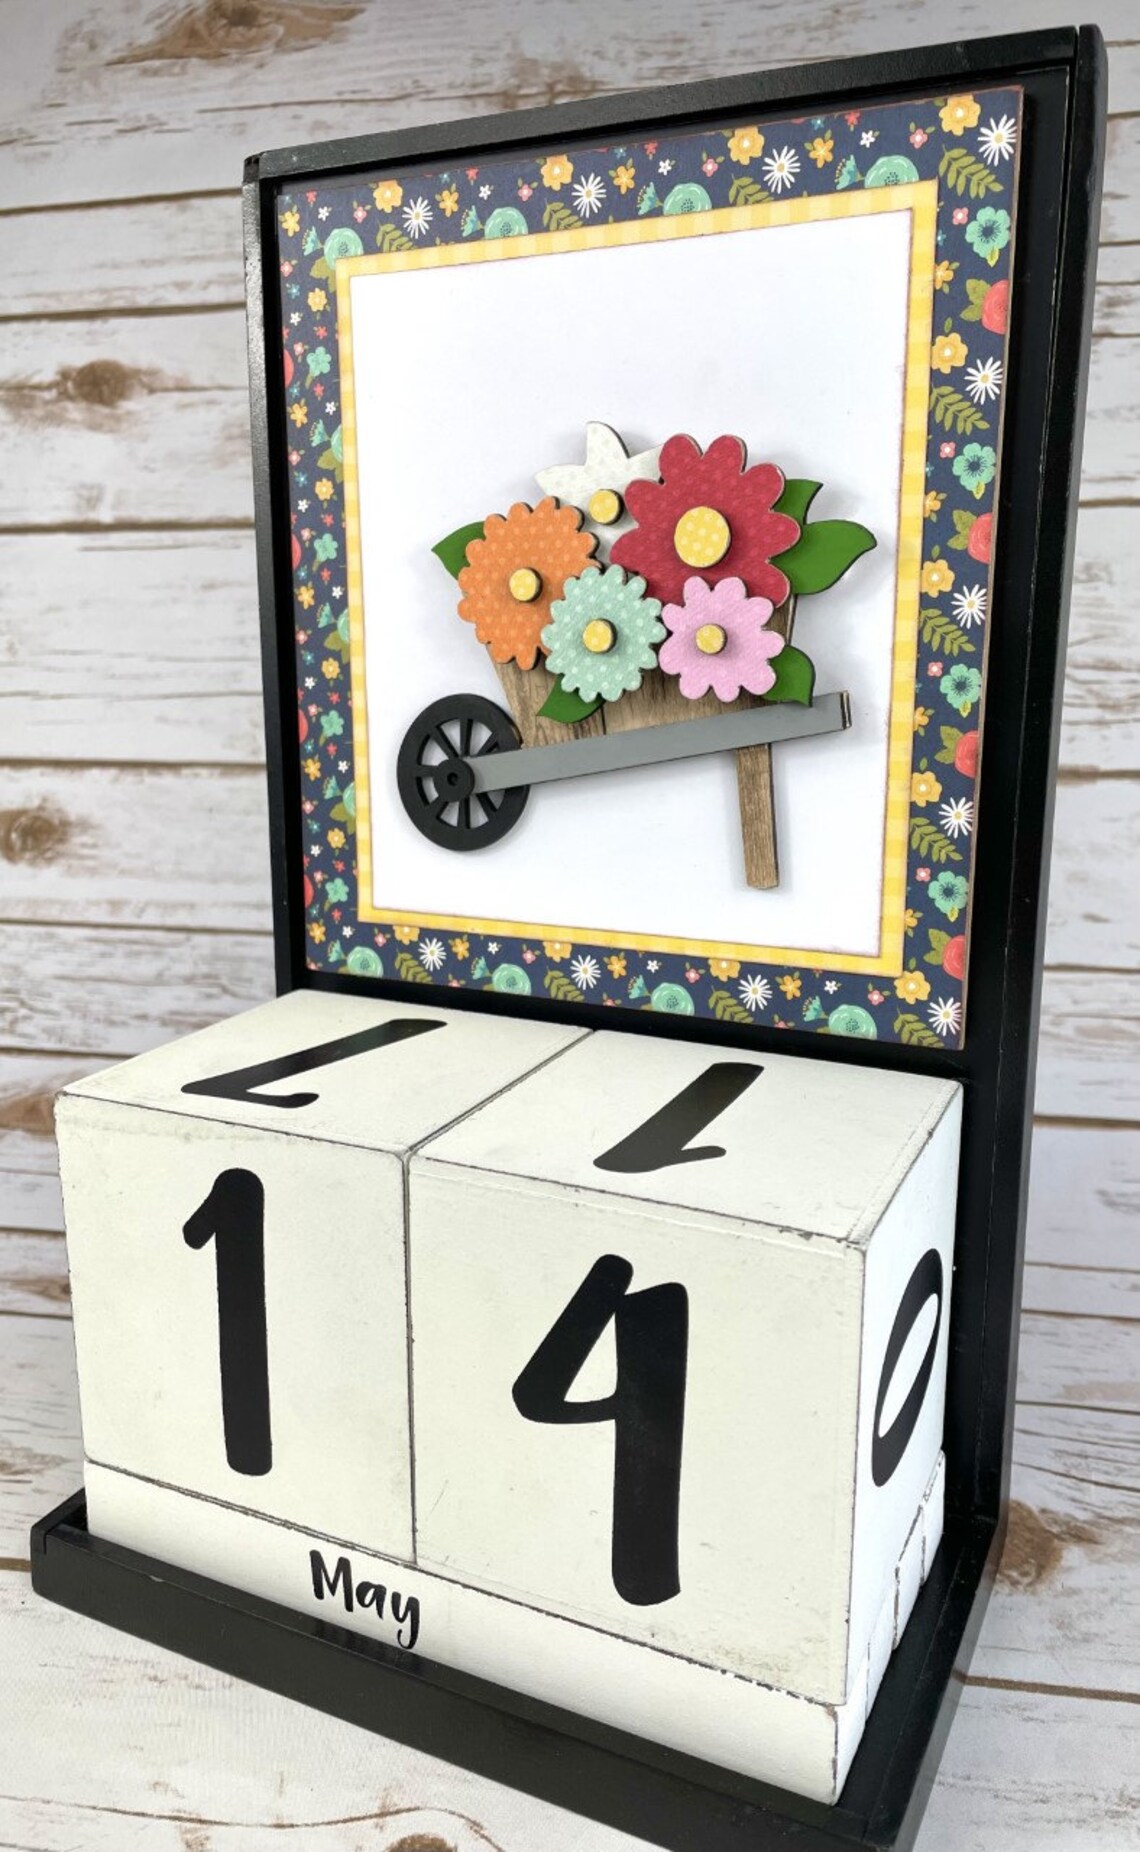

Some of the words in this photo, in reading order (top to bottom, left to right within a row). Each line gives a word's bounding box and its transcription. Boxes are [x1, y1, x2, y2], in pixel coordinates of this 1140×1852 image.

[593, 1061, 765, 1173] 1
[182, 1168, 273, 1476] 1
[511, 1254, 689, 1607] 4
[871, 1248, 943, 1487] 0
[310, 1550, 420, 1649] May
